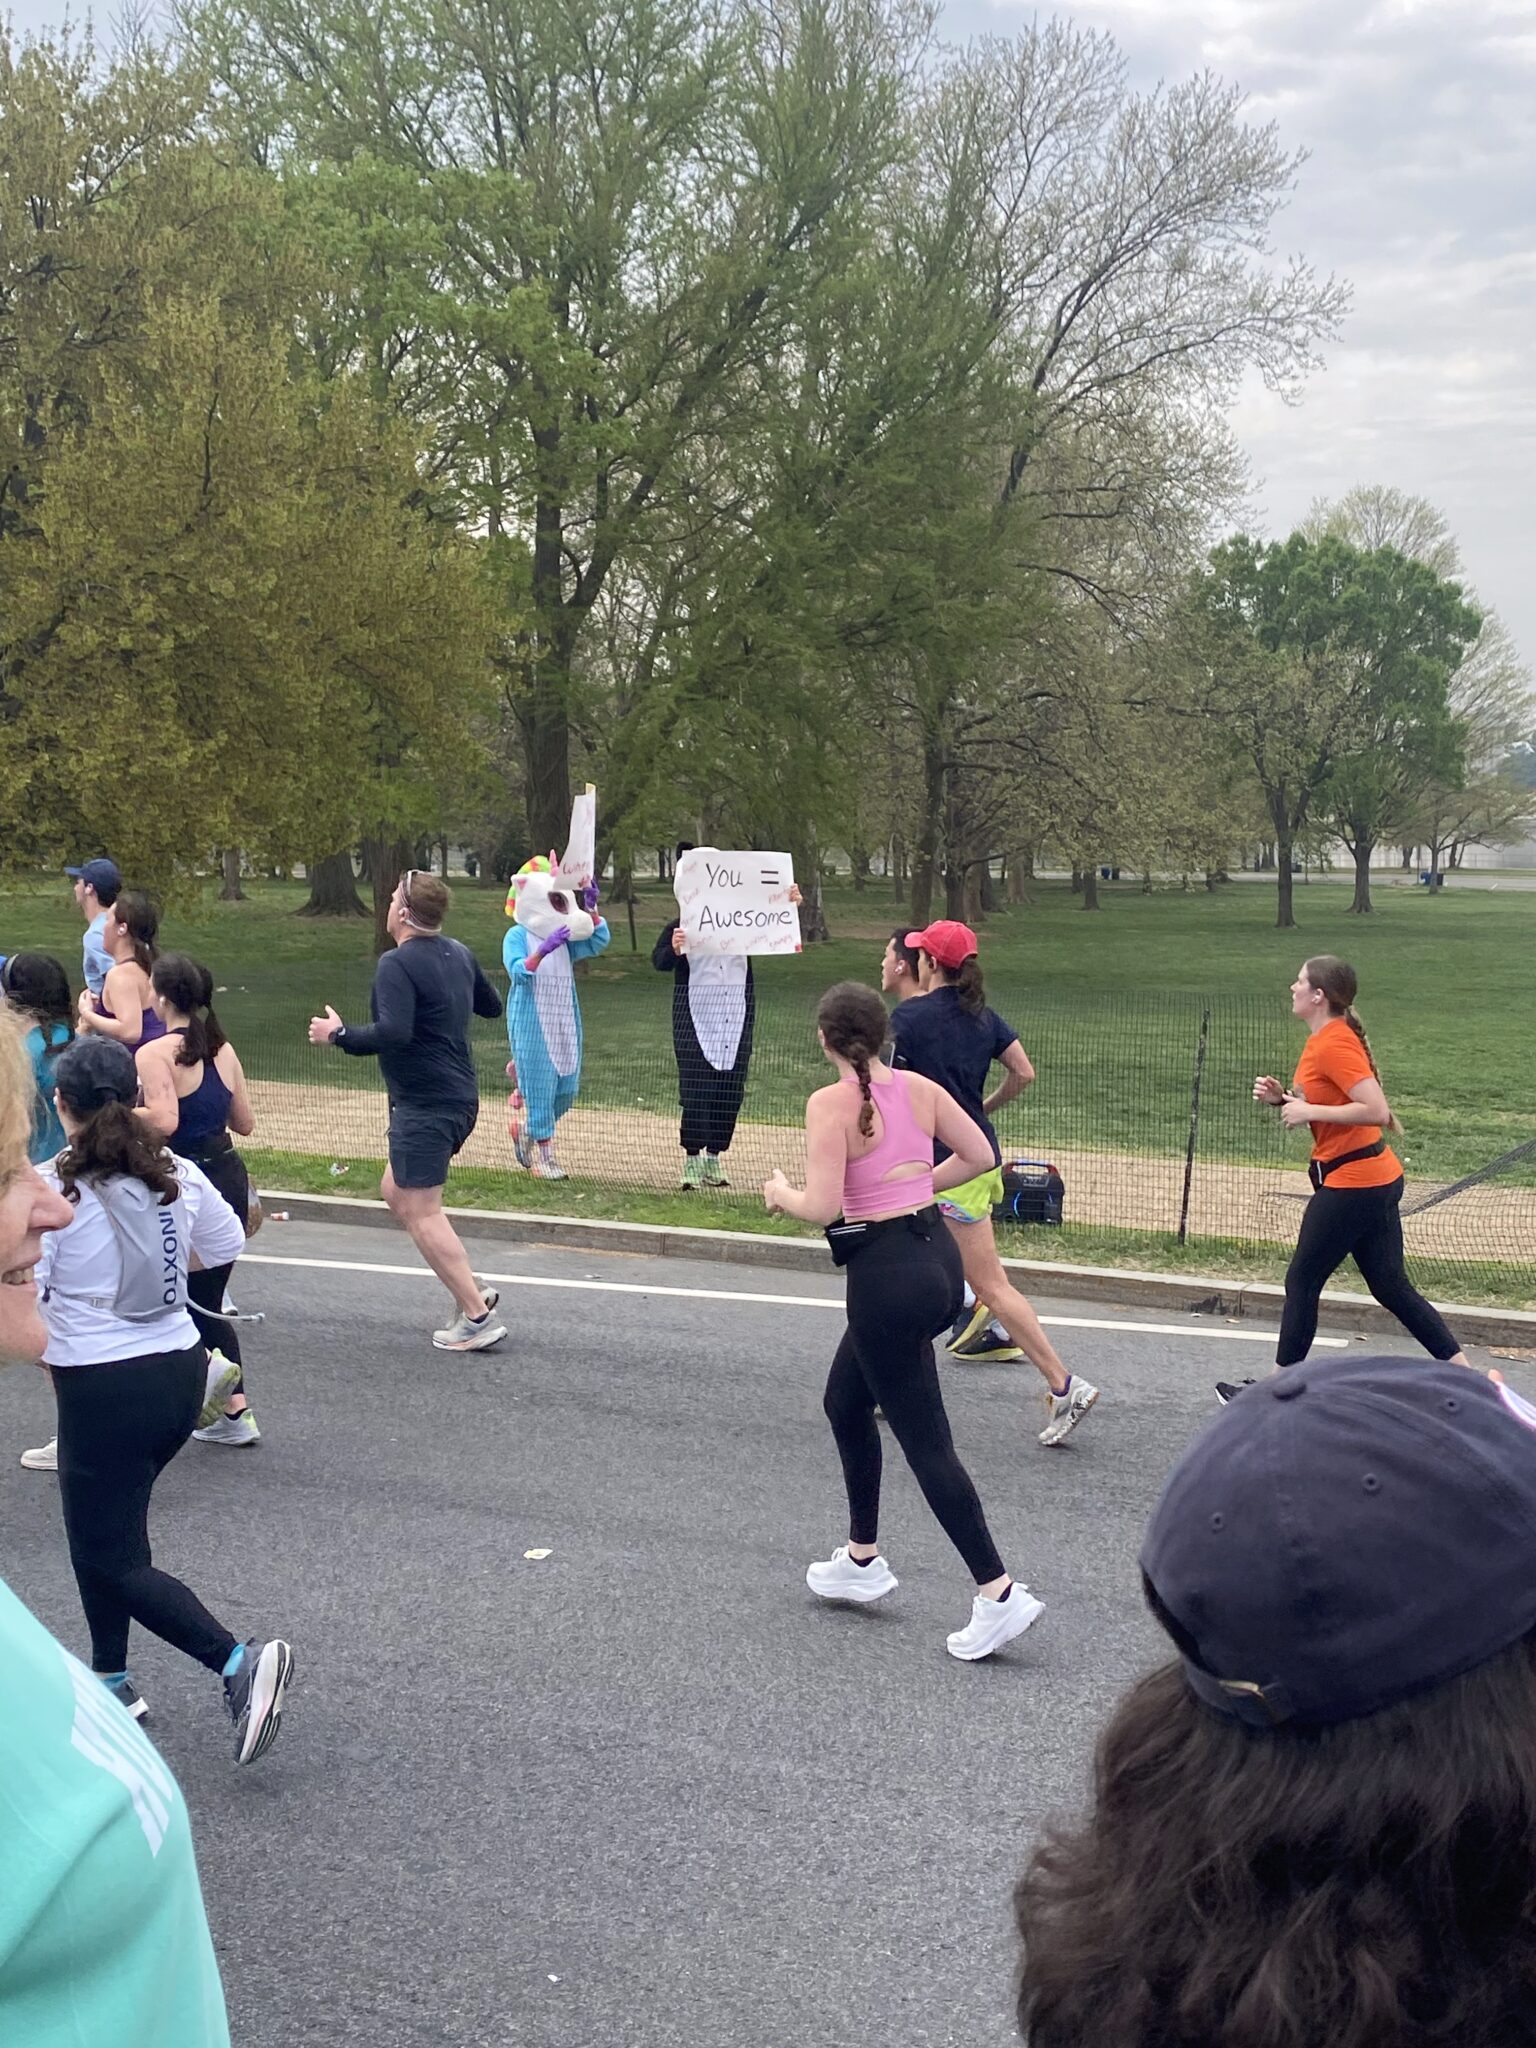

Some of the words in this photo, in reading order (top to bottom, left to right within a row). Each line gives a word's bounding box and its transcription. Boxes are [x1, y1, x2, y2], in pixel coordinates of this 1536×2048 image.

[705, 863, 743, 888] You
[760, 870, 779, 885] =
[698, 905, 793, 932] Awesome
[158, 1211, 178, 1305] INOXTO
